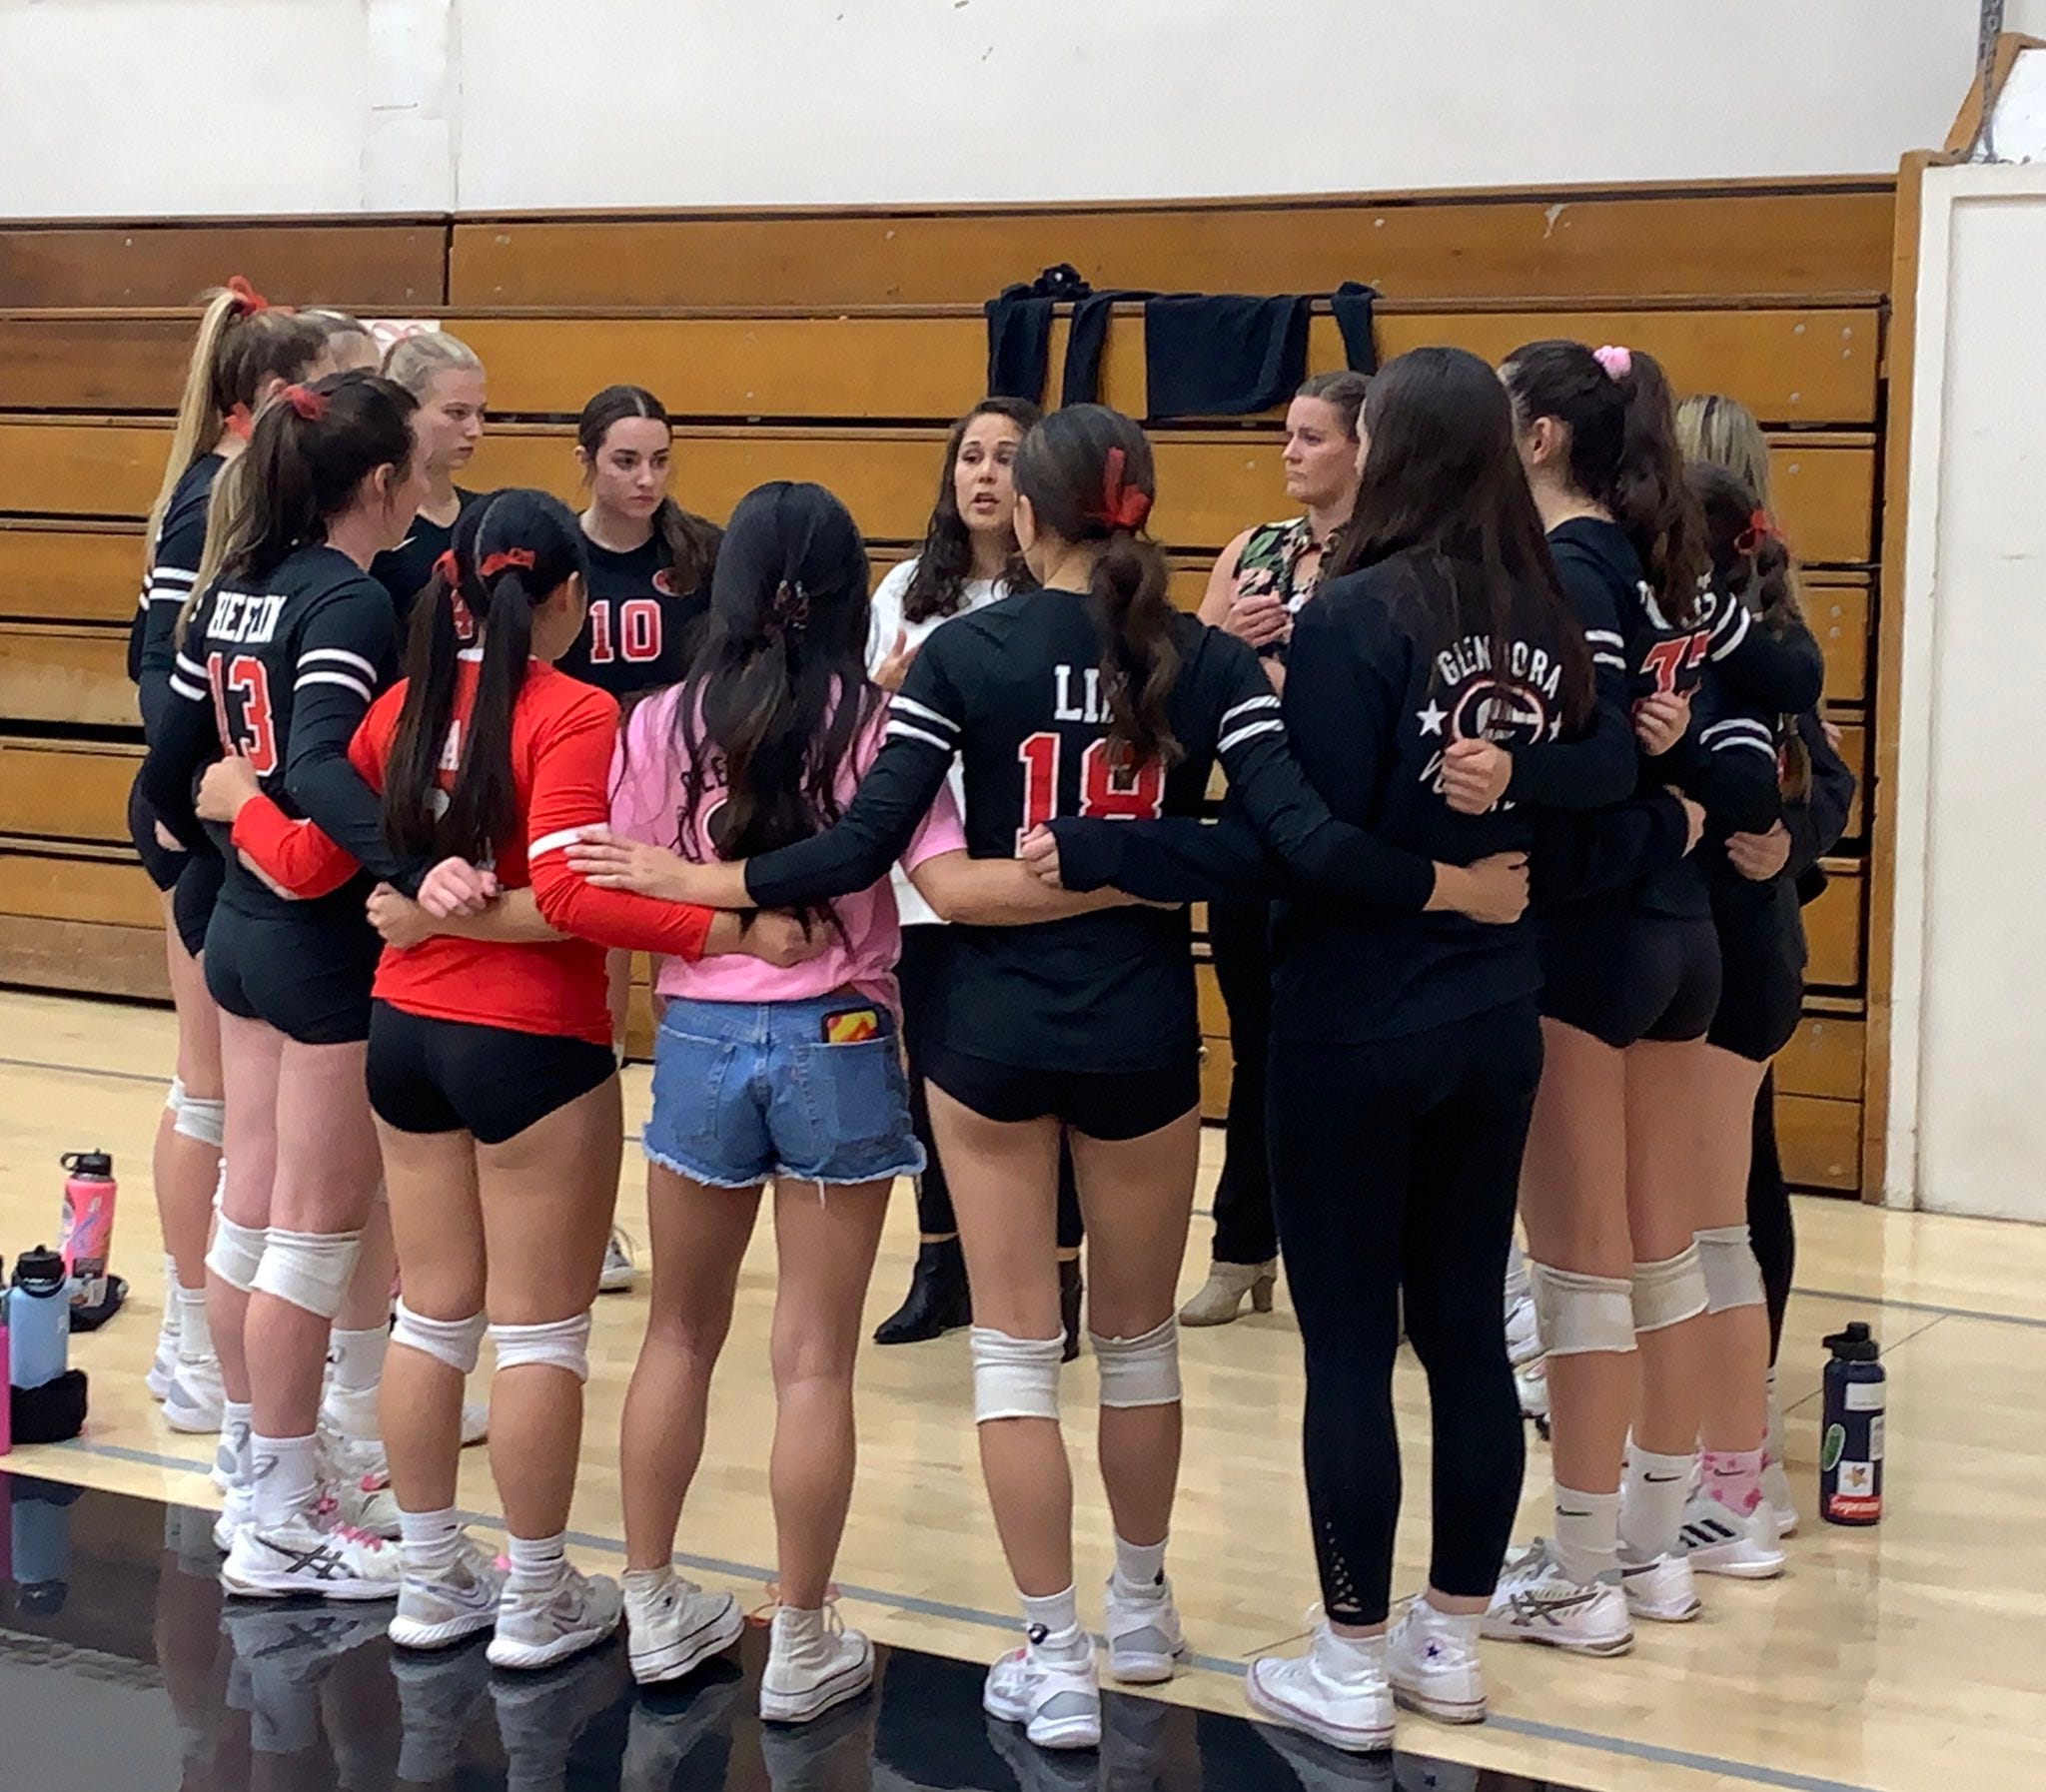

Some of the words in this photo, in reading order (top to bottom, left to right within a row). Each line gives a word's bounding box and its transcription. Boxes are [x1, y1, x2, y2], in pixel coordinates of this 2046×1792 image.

[589, 599, 661, 663] 10
[1437, 634, 1562, 700] GLENORA
[206, 651, 280, 777] 13
